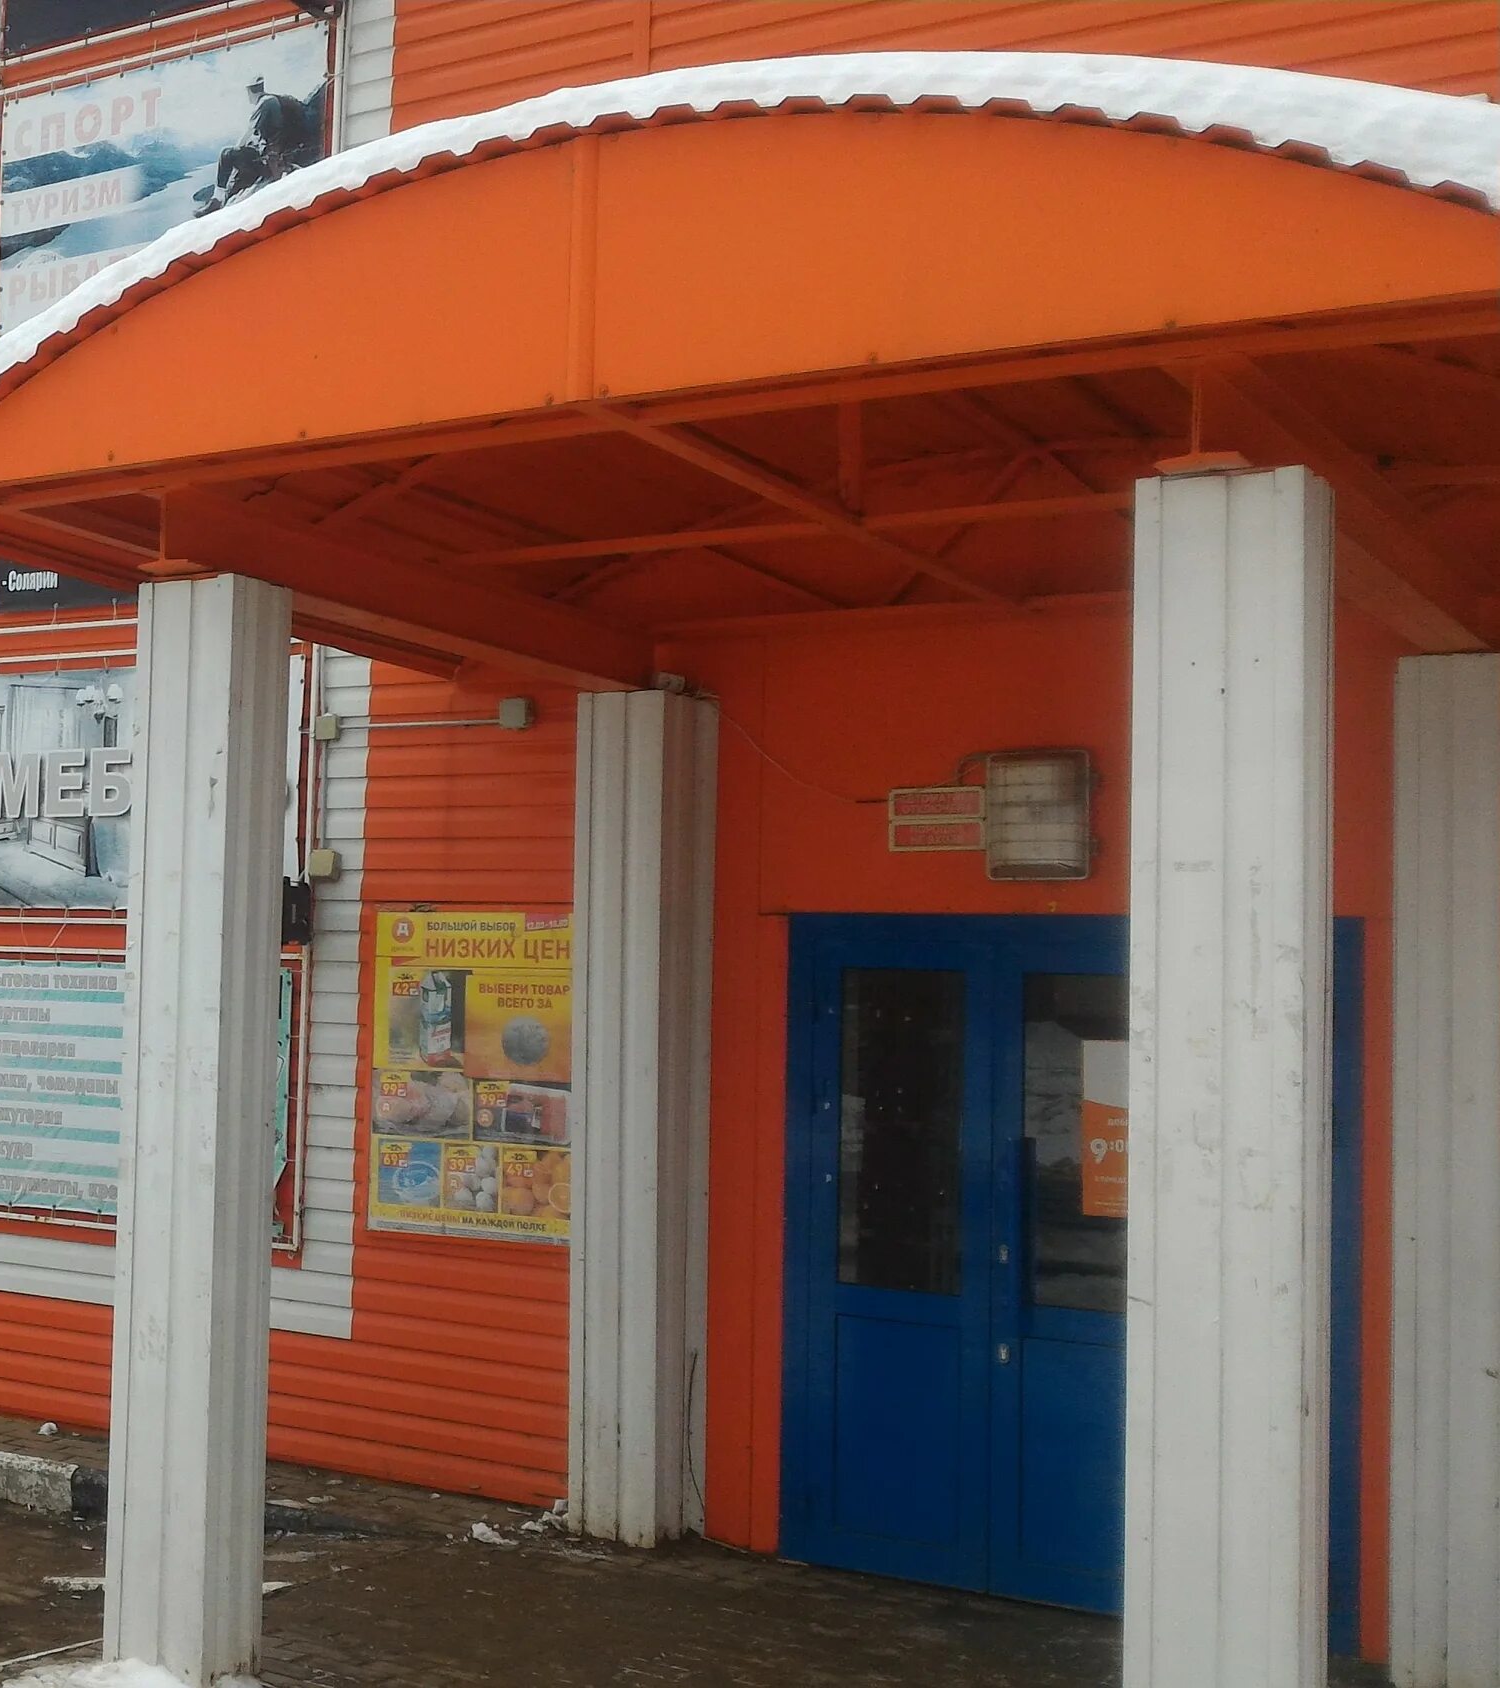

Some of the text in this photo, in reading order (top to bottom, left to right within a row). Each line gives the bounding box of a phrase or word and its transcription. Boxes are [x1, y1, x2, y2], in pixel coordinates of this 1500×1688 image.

[14, 87, 162, 157] СПОРТ
[11, 177, 123, 226] ТУРИЗМ
[427, 919, 477, 931] БОЛЬШОЙ
[480, 921, 516, 931] ВЫБОР
[426, 938, 570, 962] НИЗКИХ ЦЕН
[53, 974, 118, 991] техника
[479, 983, 571, 996] ВЫБЕРИ ТОВАР
[497, 997, 553, 1009] ВСЕГО ЗА
[37, 1075, 119, 1097] чемоданы
[475, 1217, 515, 1229] КАЖДОЙ
[516, 1220, 546, 1232] ПОЛКЕ
